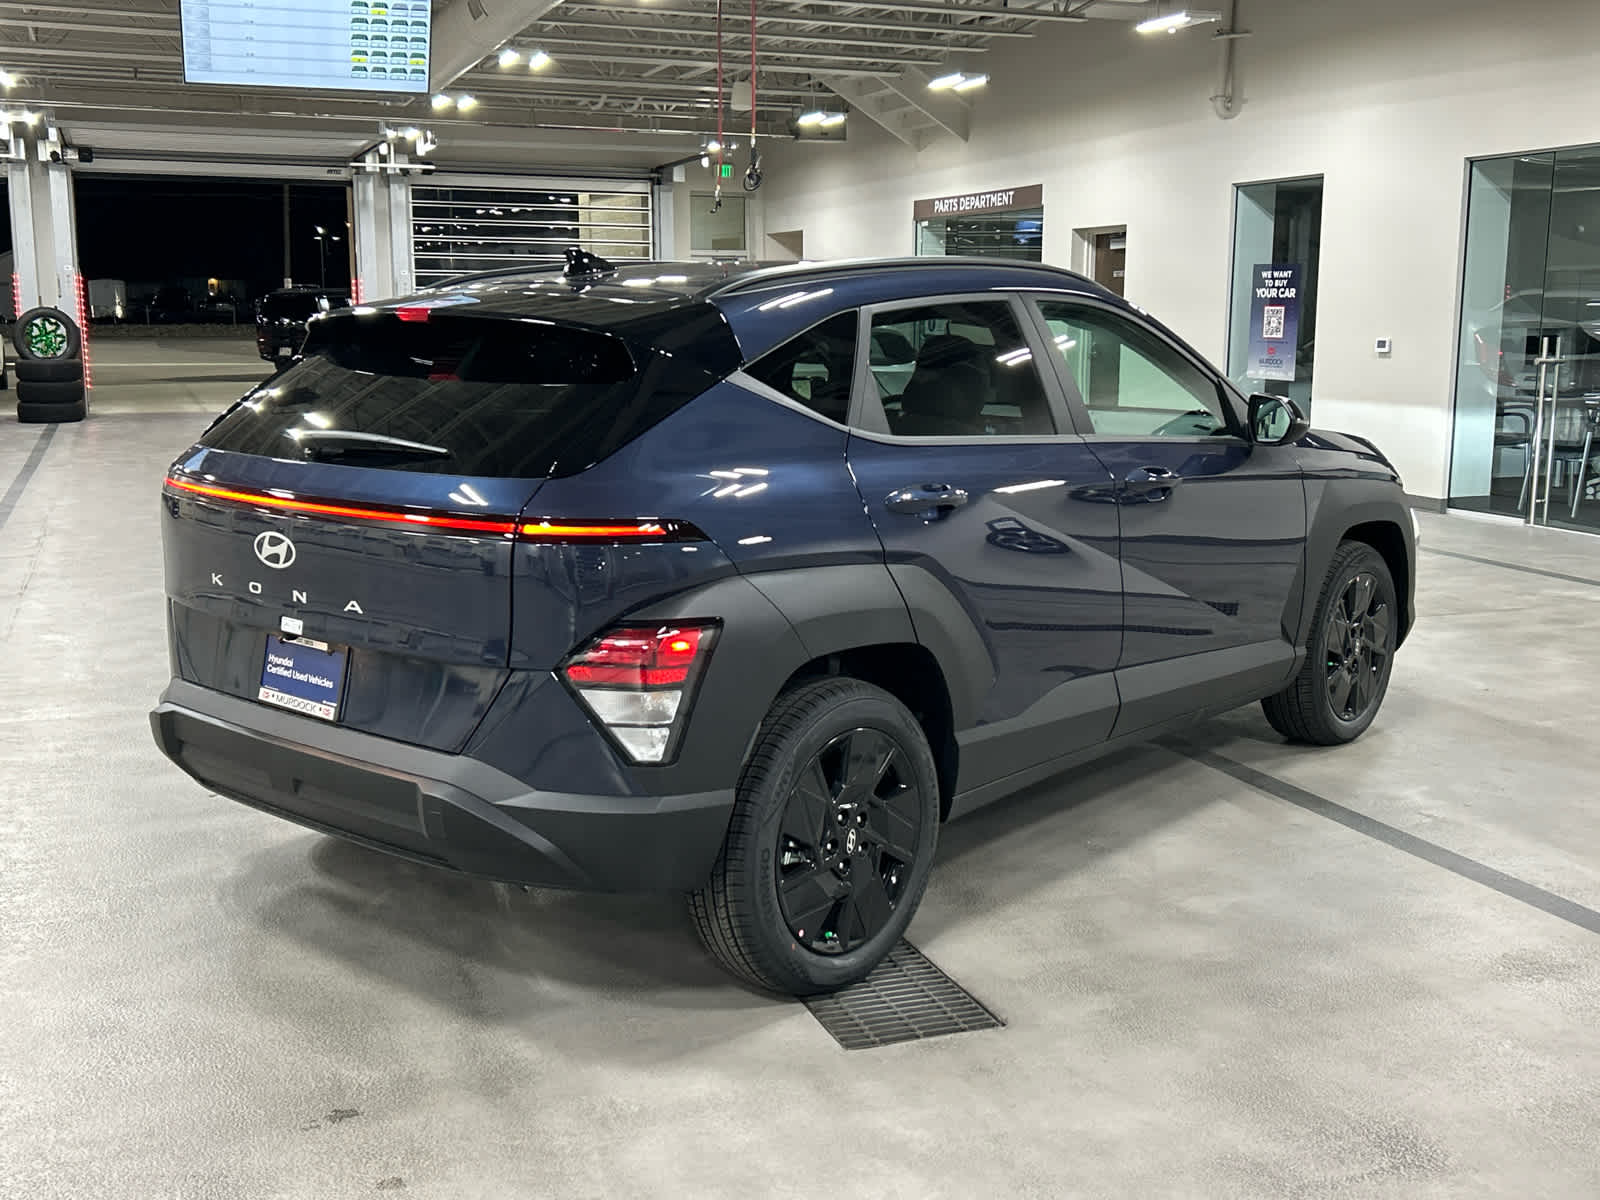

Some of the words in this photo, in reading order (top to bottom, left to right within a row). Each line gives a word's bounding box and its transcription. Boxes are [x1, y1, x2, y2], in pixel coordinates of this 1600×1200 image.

[934, 199, 958, 213] PARTS
[959, 191, 1015, 210] DEPARTMENT
[1261, 270, 1272, 279] WE
[1272, 270, 1293, 279] WANT
[1264, 279, 1274, 287] TO
[1274, 279, 1288, 287] BUY
[1255, 287, 1278, 298] YOUR
[1278, 287, 1297, 298] CAR
[211, 572, 364, 615] KONA
[268, 653, 294, 668] Hyundai
[266, 664, 292, 679] Certified
[292, 669, 309, 682] Used
[308, 673, 334, 689] Vehicles
[276, 693, 318, 713] MURDOCK
